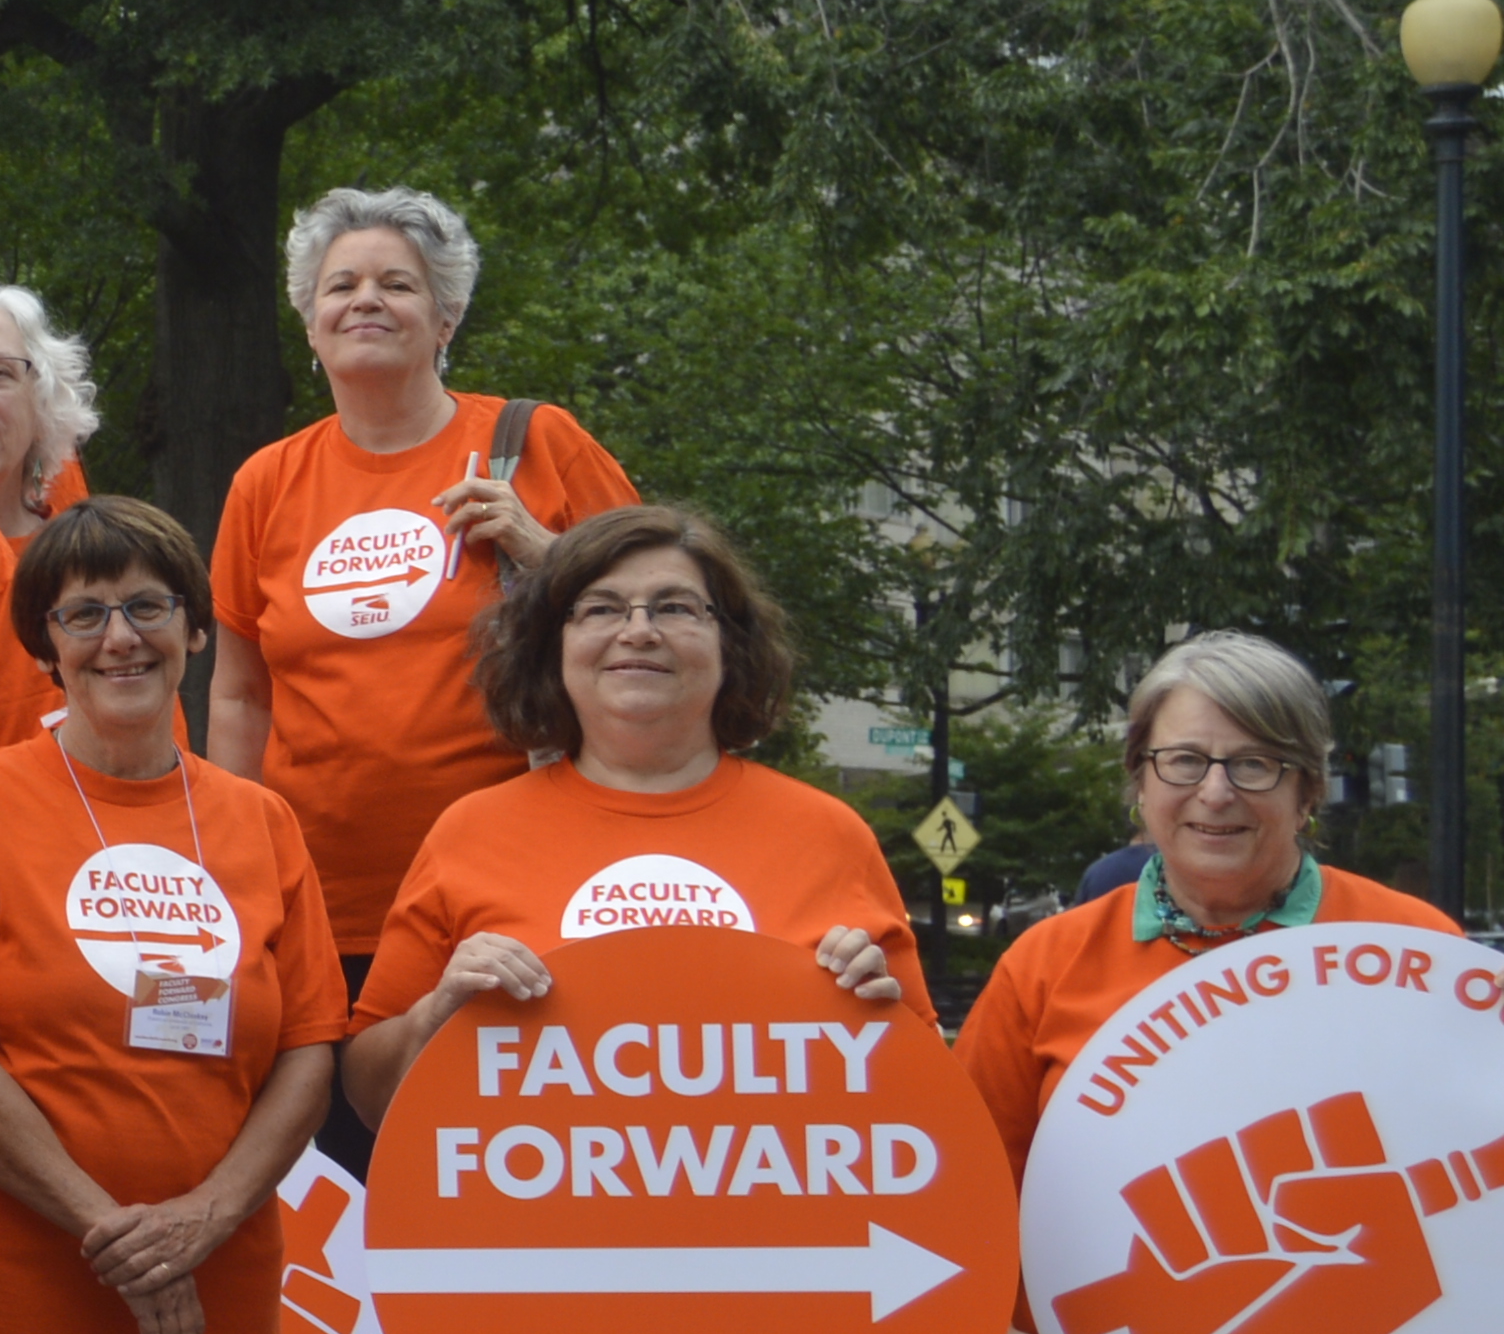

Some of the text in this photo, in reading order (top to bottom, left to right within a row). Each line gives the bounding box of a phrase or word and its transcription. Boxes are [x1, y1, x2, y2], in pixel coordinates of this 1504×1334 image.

[329, 525, 427, 555] FACULTY
[317, 545, 434, 576] FORWARD
[351, 611, 389, 626] SEIU
[89, 870, 205, 896] FACULTY
[591, 882, 722, 903] FACULTY
[80, 897, 222, 923] FORWARD
[578, 907, 738, 927] FORWARD
[1076, 943, 1432, 1117] UNITING FOR
[475, 1021, 890, 1097] FACULTY
[434, 1123, 938, 1200] FORWARD
